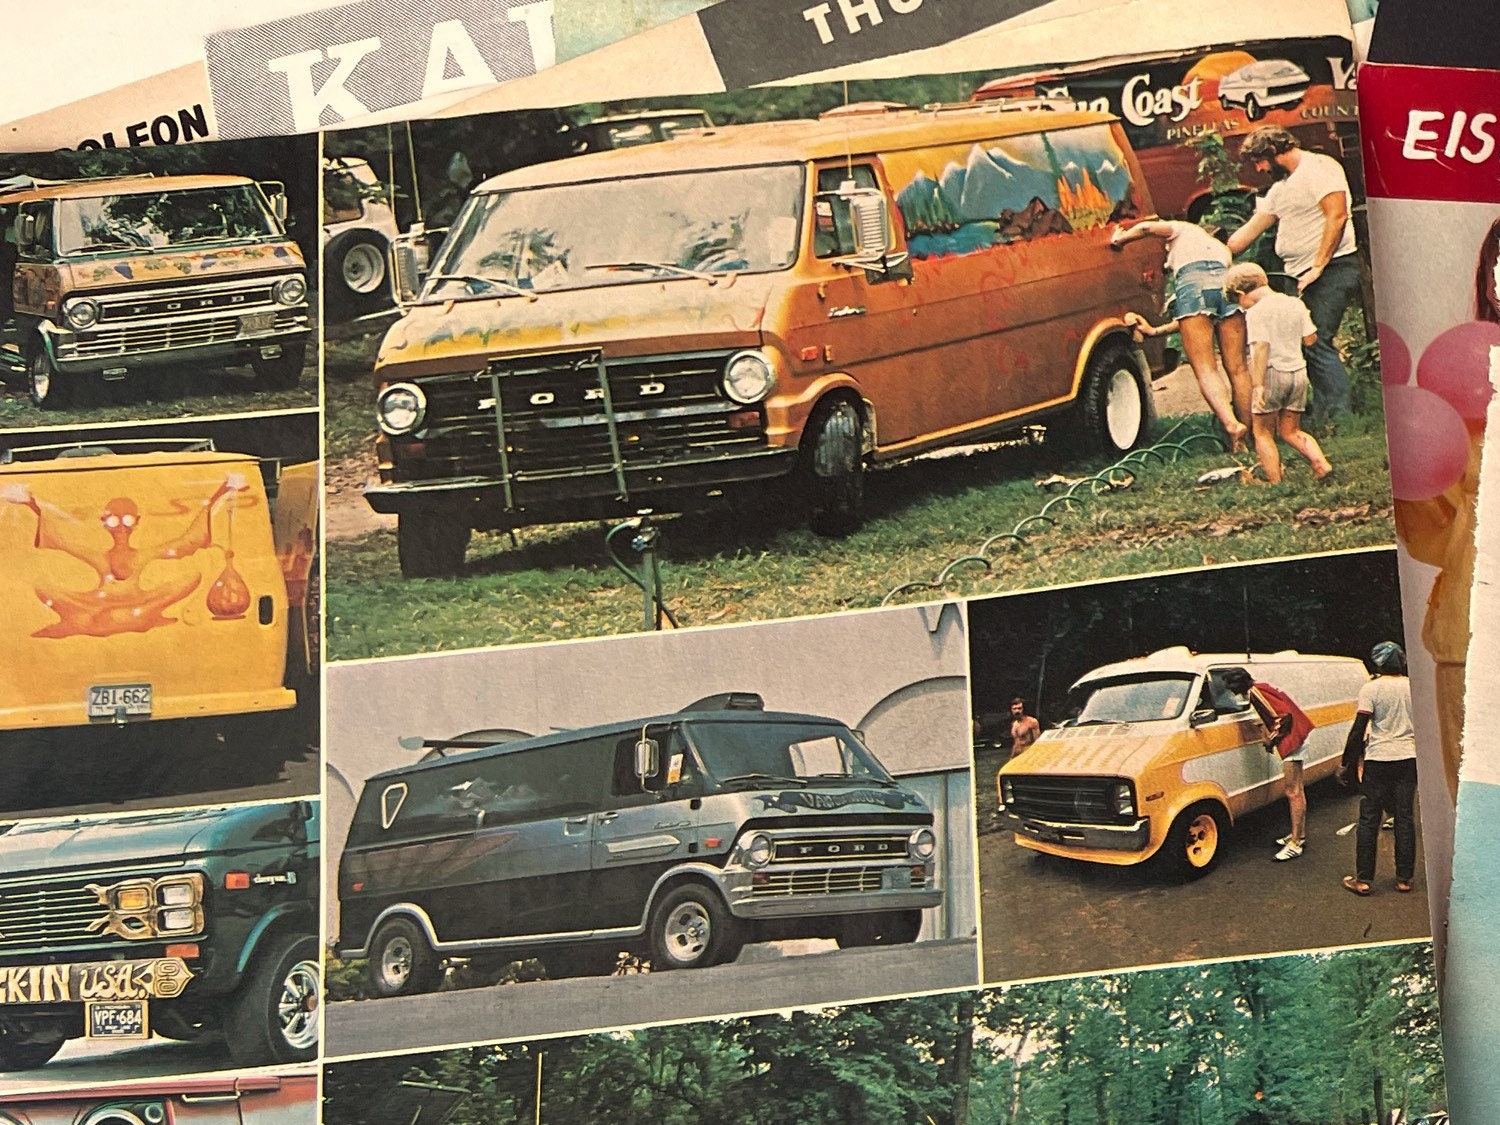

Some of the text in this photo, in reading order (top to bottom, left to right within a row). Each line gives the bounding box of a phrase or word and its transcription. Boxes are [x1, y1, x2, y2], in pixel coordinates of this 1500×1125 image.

[1122, 73, 1203, 126] Coast
[477, 382, 666, 410] FORD
[799, 843, 890, 854] FORD
